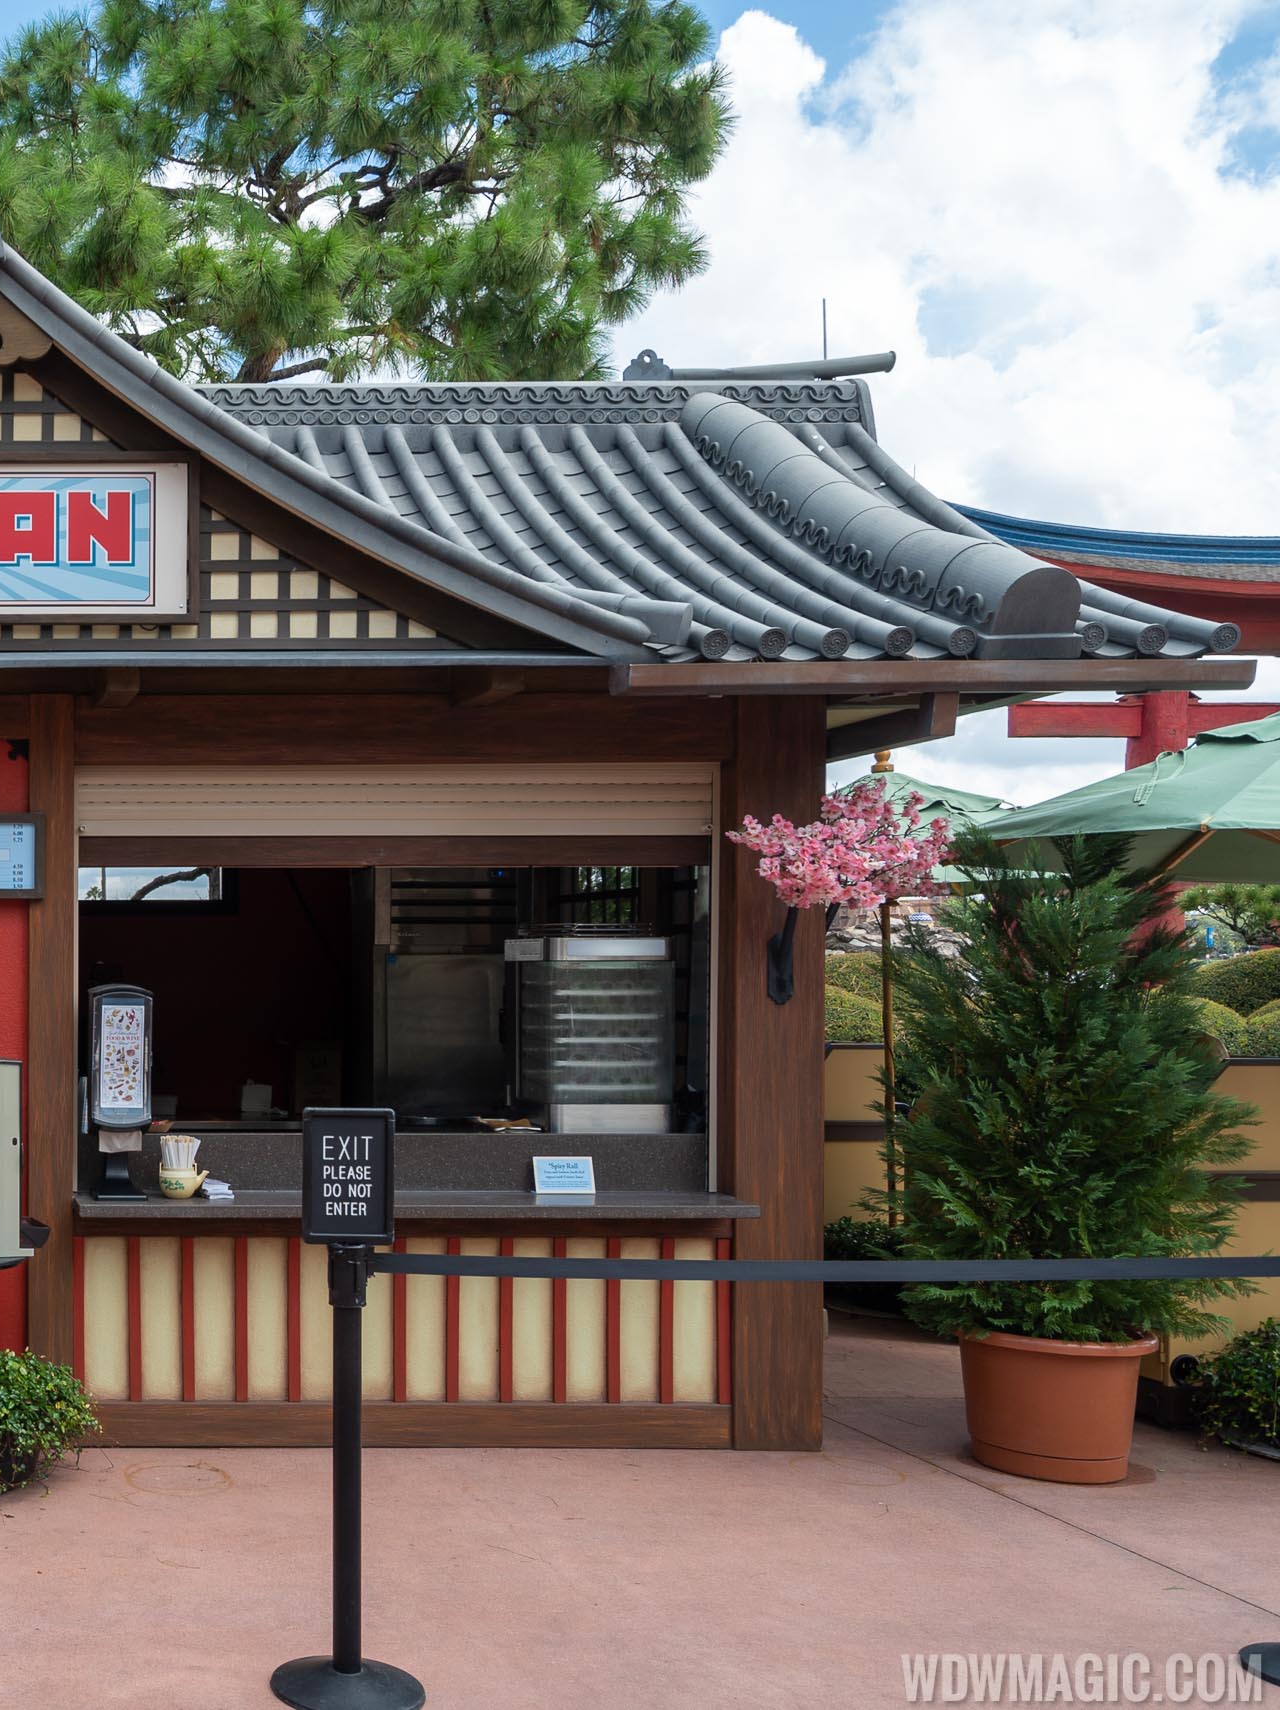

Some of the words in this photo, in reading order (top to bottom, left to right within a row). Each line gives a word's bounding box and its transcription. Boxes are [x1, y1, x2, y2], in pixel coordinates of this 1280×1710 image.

[322, 1135, 374, 1161] EXIT
[322, 1165, 372, 1181] PLEASE
[323, 1183, 342, 1198] DO
[348, 1183, 373, 1199] NOT
[325, 1201, 368, 1217] ENTER
